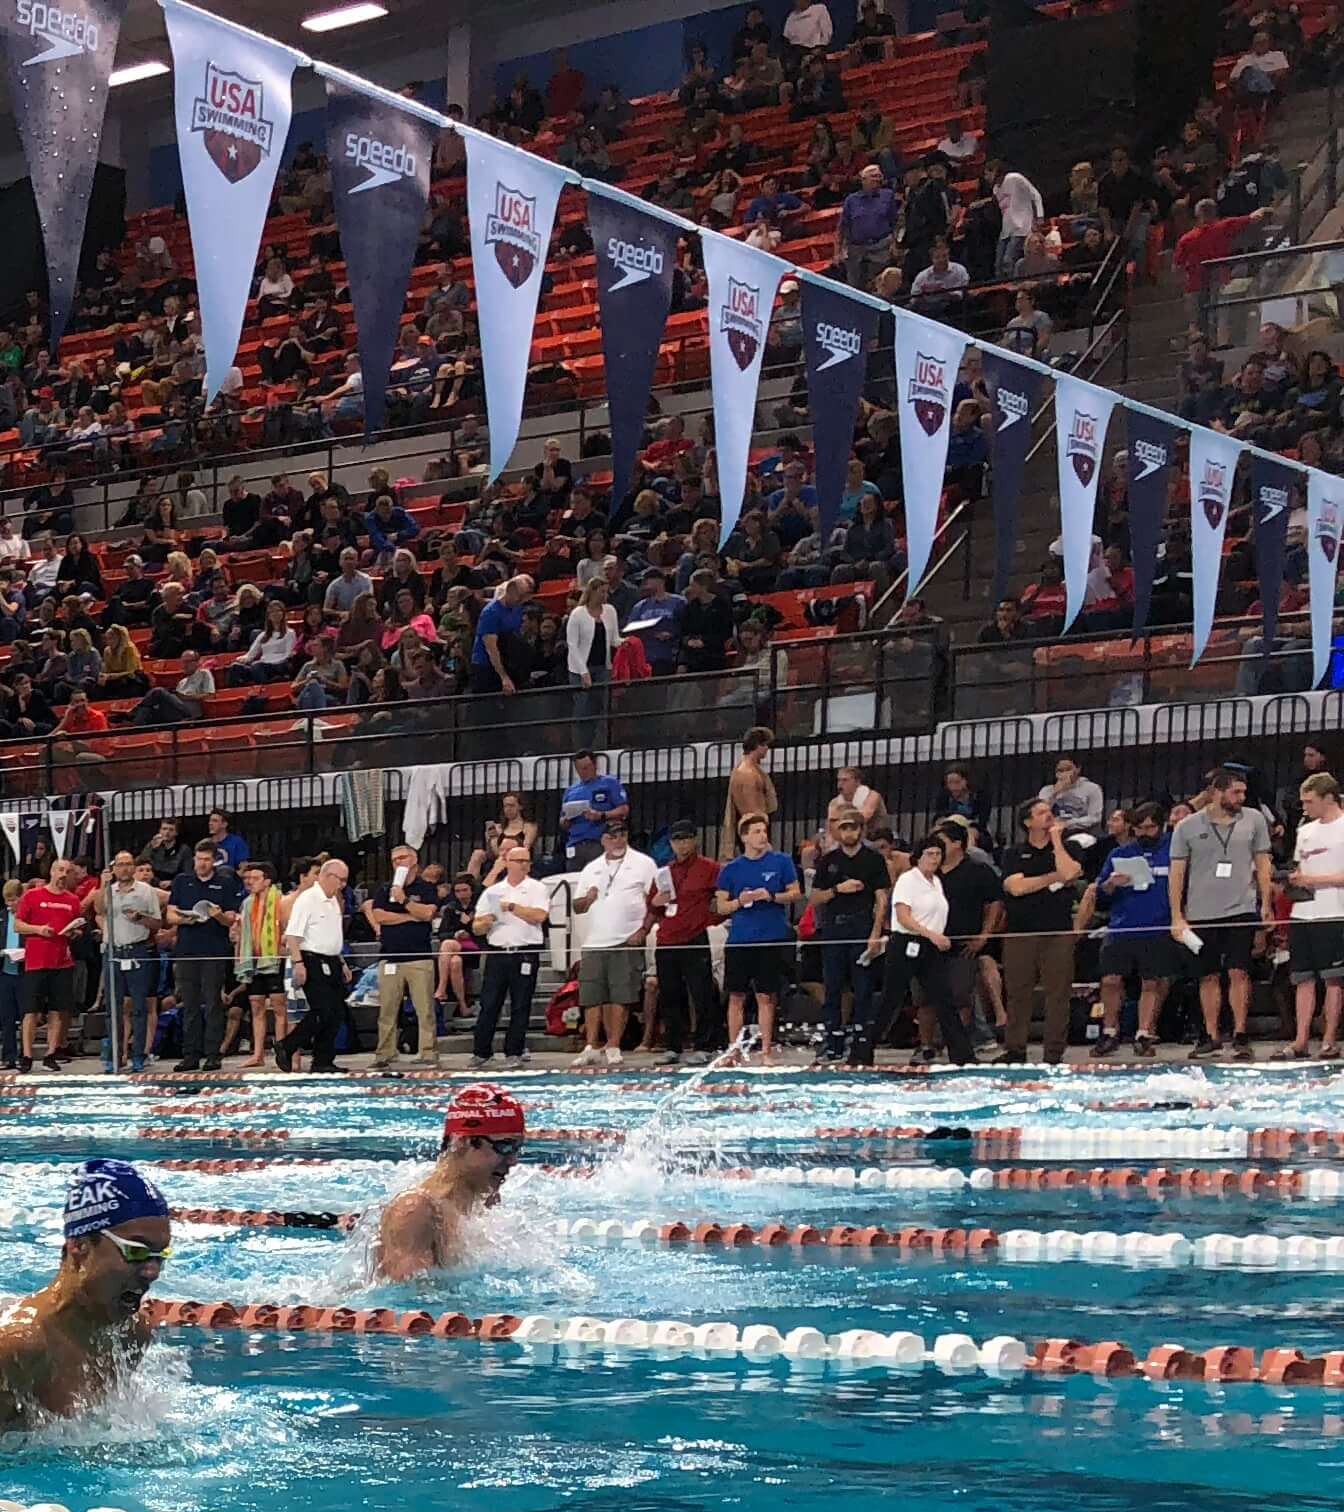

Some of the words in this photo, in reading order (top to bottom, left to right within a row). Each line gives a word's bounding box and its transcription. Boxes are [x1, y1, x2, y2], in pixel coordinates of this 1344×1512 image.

[16, 1, 99, 50] speedo
[211, 77, 257, 118] USA
[197, 106, 267, 141] SWIMMING
[345, 133, 416, 176] speedo
[501, 195, 530, 229] USA
[608, 238, 662, 274] speedo
[732, 287, 755, 317] USA
[816, 323, 861, 353] speedo
[918, 362, 944, 388] USA
[484, 1109, 517, 1118] TEAM
